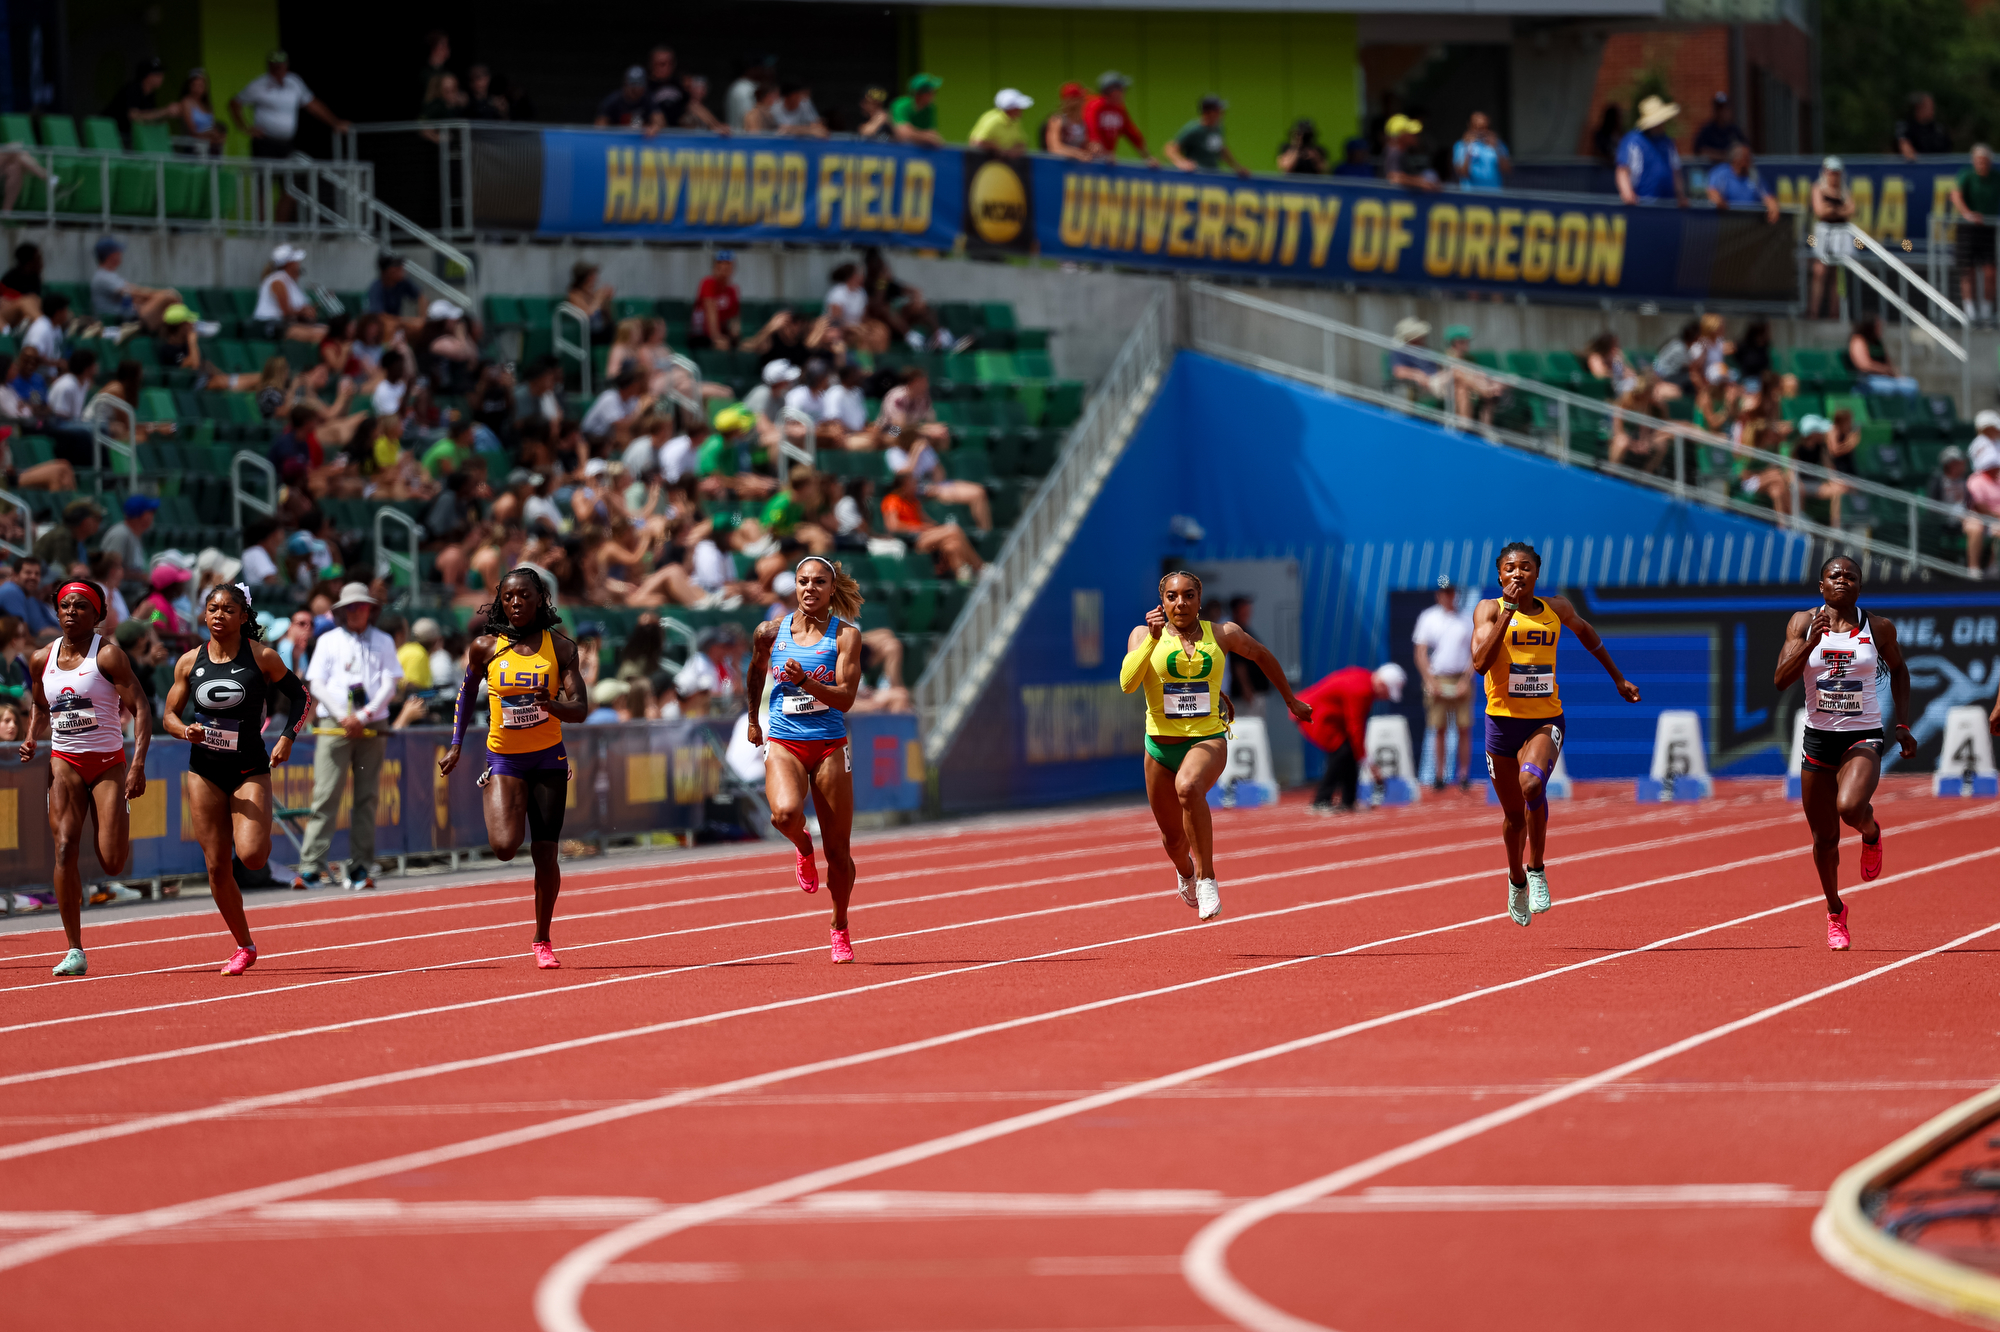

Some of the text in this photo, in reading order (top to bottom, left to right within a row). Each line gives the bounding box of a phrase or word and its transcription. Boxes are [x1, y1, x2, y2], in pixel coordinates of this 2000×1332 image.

[603, 147, 935, 234] HAYWARD FIELD
[1059, 172, 1628, 287] UNIVERSITY OF OREGON
[1511, 630, 1556, 646] LSU
[500, 672, 549, 688] LSU
[1514, 683, 1549, 692] GODBLESS
[196, 679, 245, 709] G
[1823, 692, 1855, 701] ROSEMARY
[512, 706, 539, 715] BRIANNA
[795, 703, 815, 712] LONG
[1177, 703, 1198, 711] MAYS
[1818, 700, 1861, 710] CHUKWUMA
[58, 718, 93, 729] BERTRAND
[513, 713, 540, 724] LYSTON
[204, 736, 231, 748] CKSON
[1952, 736, 1981, 772] 4
